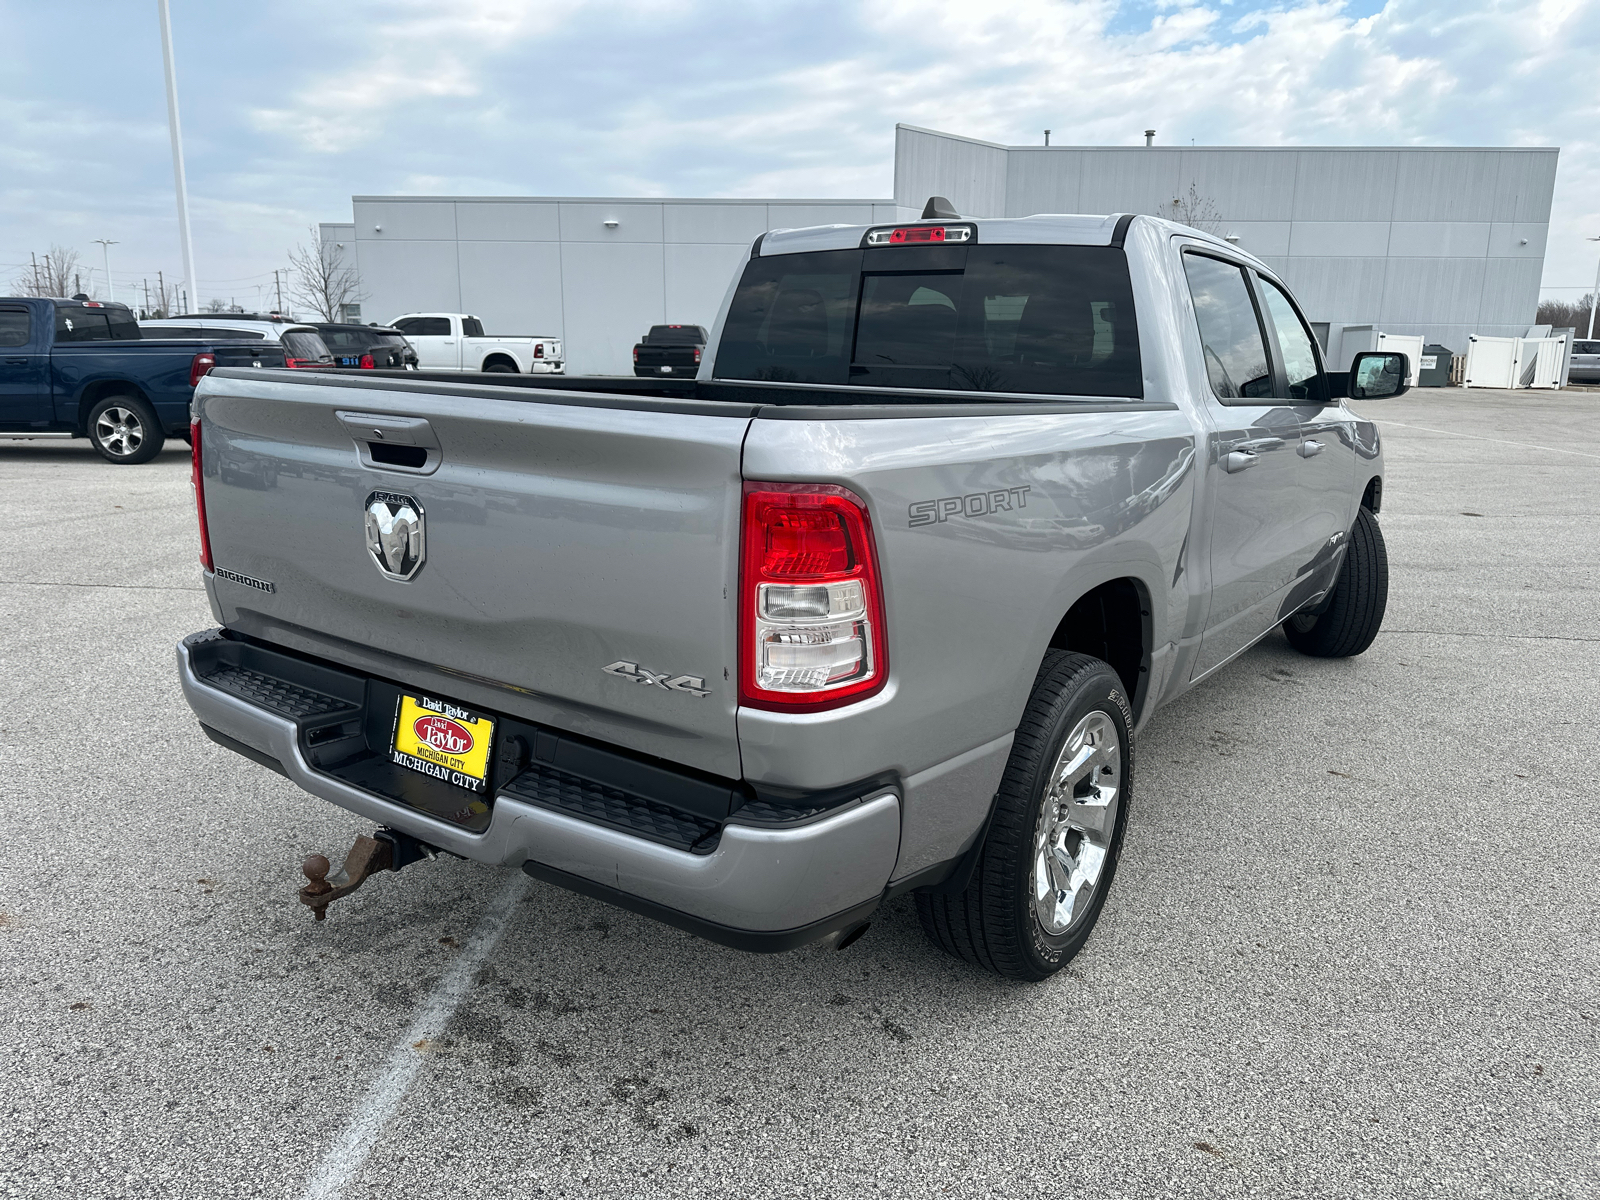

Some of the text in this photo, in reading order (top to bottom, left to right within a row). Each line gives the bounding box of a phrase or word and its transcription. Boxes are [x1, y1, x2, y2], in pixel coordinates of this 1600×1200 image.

[374, 491, 409, 505] RAM
[908, 485, 1031, 528] SPORT
[216, 567, 272, 593] BIGHORN
[423, 697, 469, 720] David Taylor
[431, 717, 447, 730] David
[423, 724, 467, 752] Taylor
[417, 747, 465, 770] MICHIGAN CITY
[393, 751, 480, 791] MICHIGAN CITY
